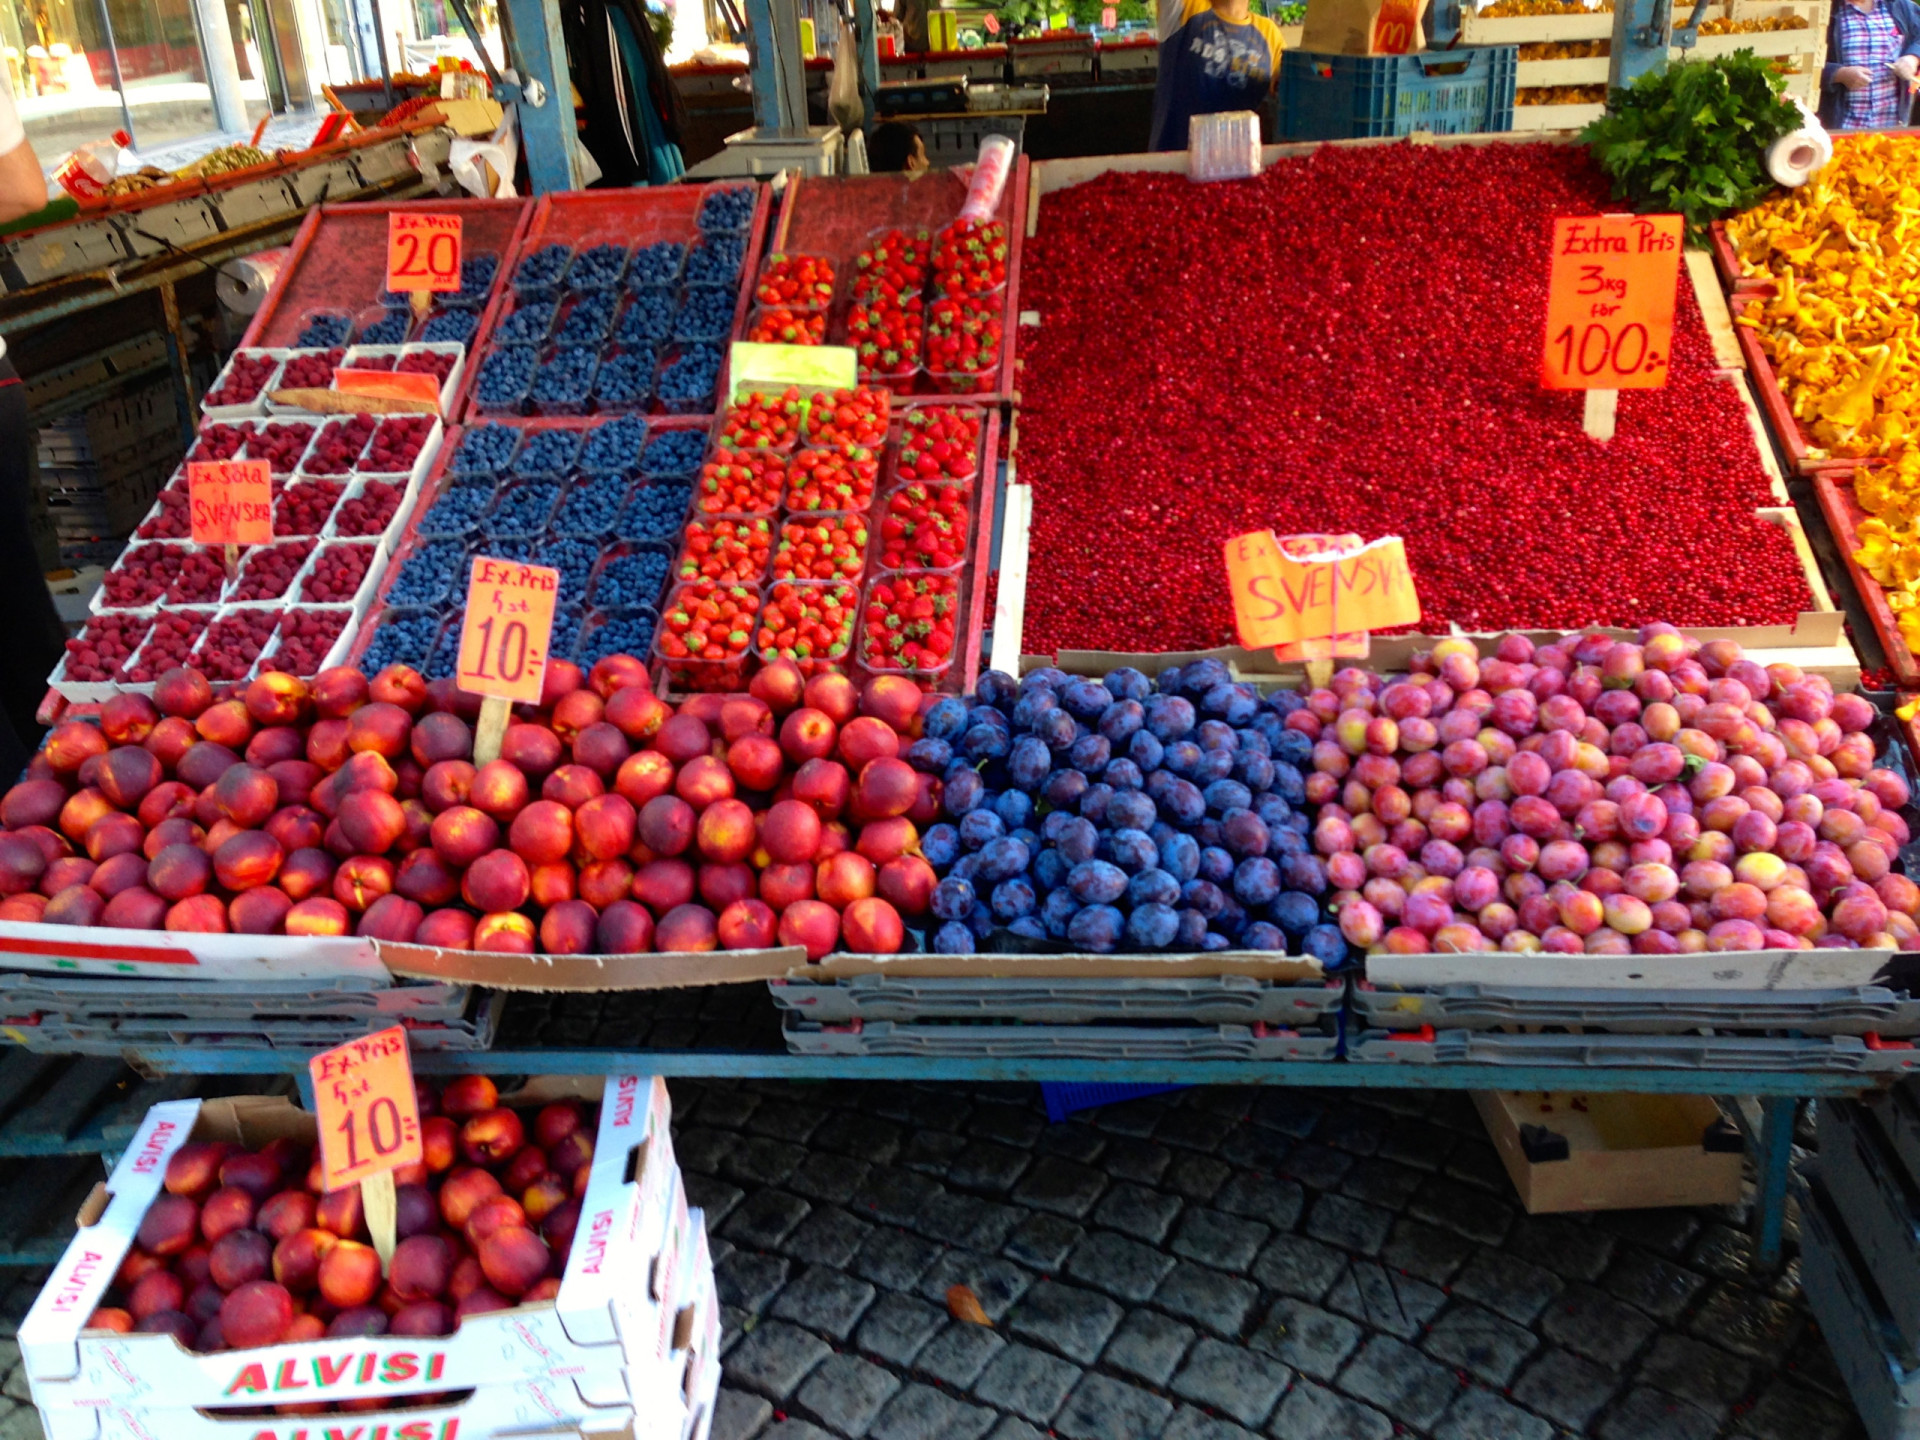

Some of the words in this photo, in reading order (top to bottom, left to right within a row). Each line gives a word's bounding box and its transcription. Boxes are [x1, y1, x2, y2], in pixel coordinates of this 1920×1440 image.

[391, 233, 458, 277] 20
[1561, 224, 1629, 255] Extra
[1630, 220, 1676, 254] Pris
[132, 1120, 176, 1173] ALVISI
[582, 1209, 614, 1274] ALVISI
[51, 1251, 103, 1313] ALVISI
[222, 1351, 447, 1398] ALVISI
